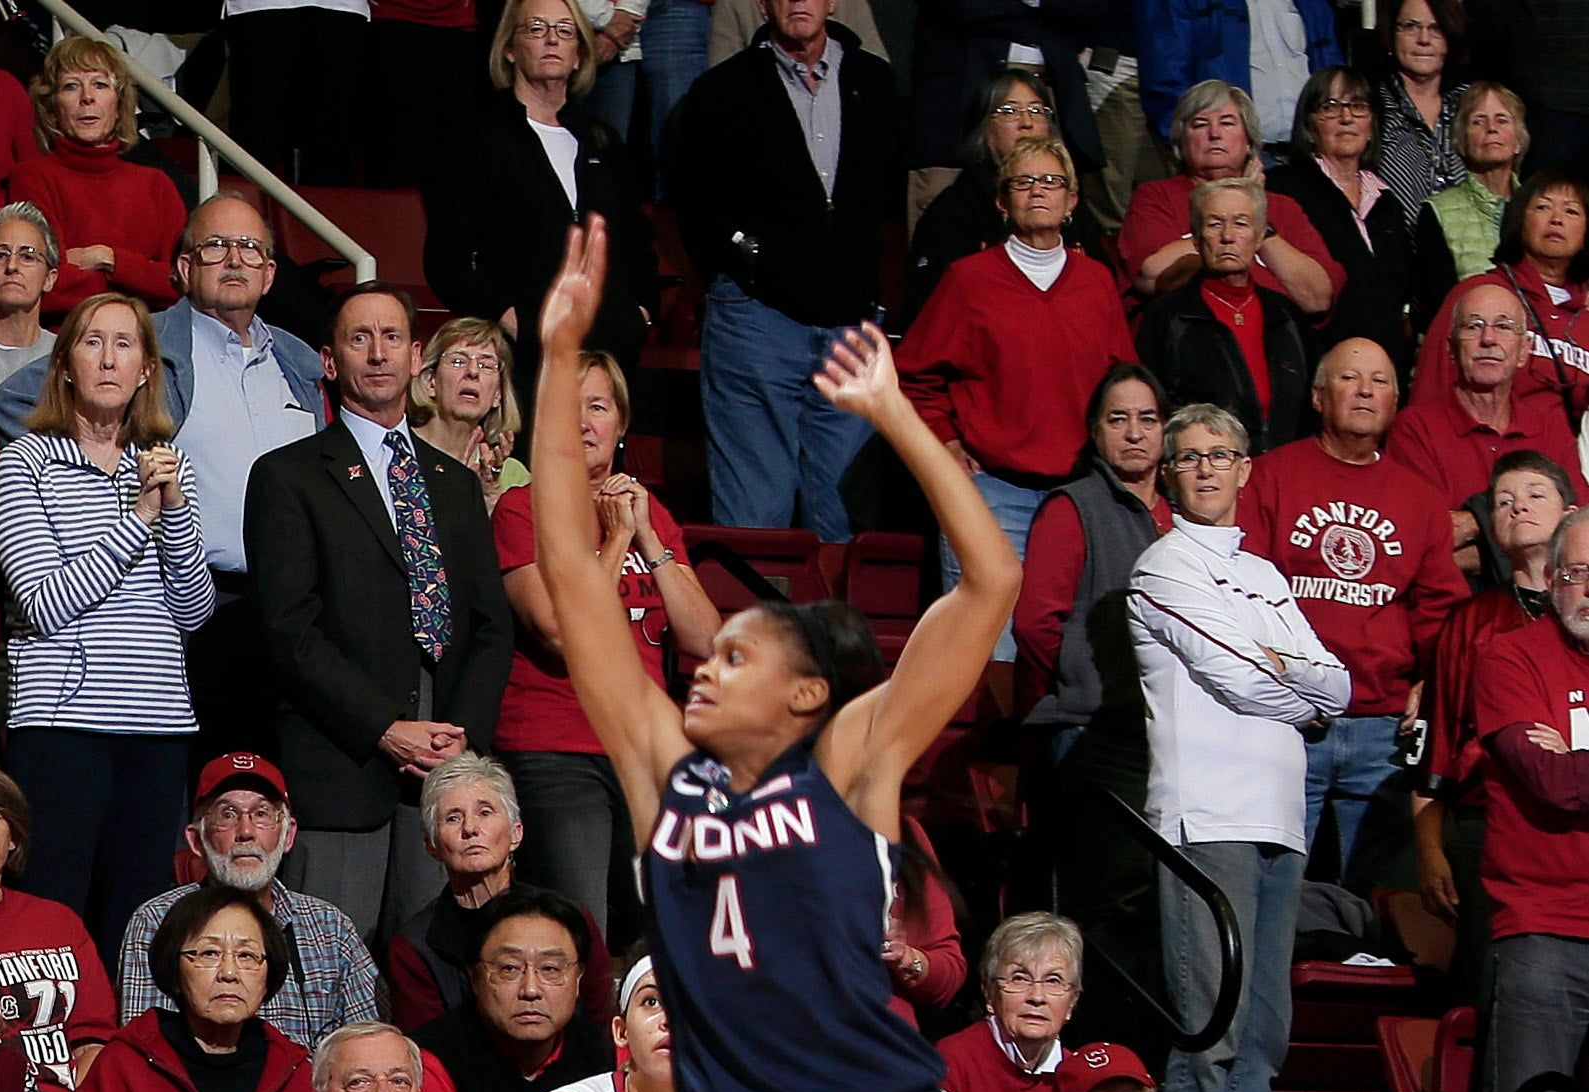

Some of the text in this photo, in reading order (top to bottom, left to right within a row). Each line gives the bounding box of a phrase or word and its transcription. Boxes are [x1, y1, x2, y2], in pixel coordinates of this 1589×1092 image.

[1290, 501, 1404, 557] STANFORD
[1292, 575, 1397, 607] UNIVERSITY
[710, 874, 754, 970] 4
